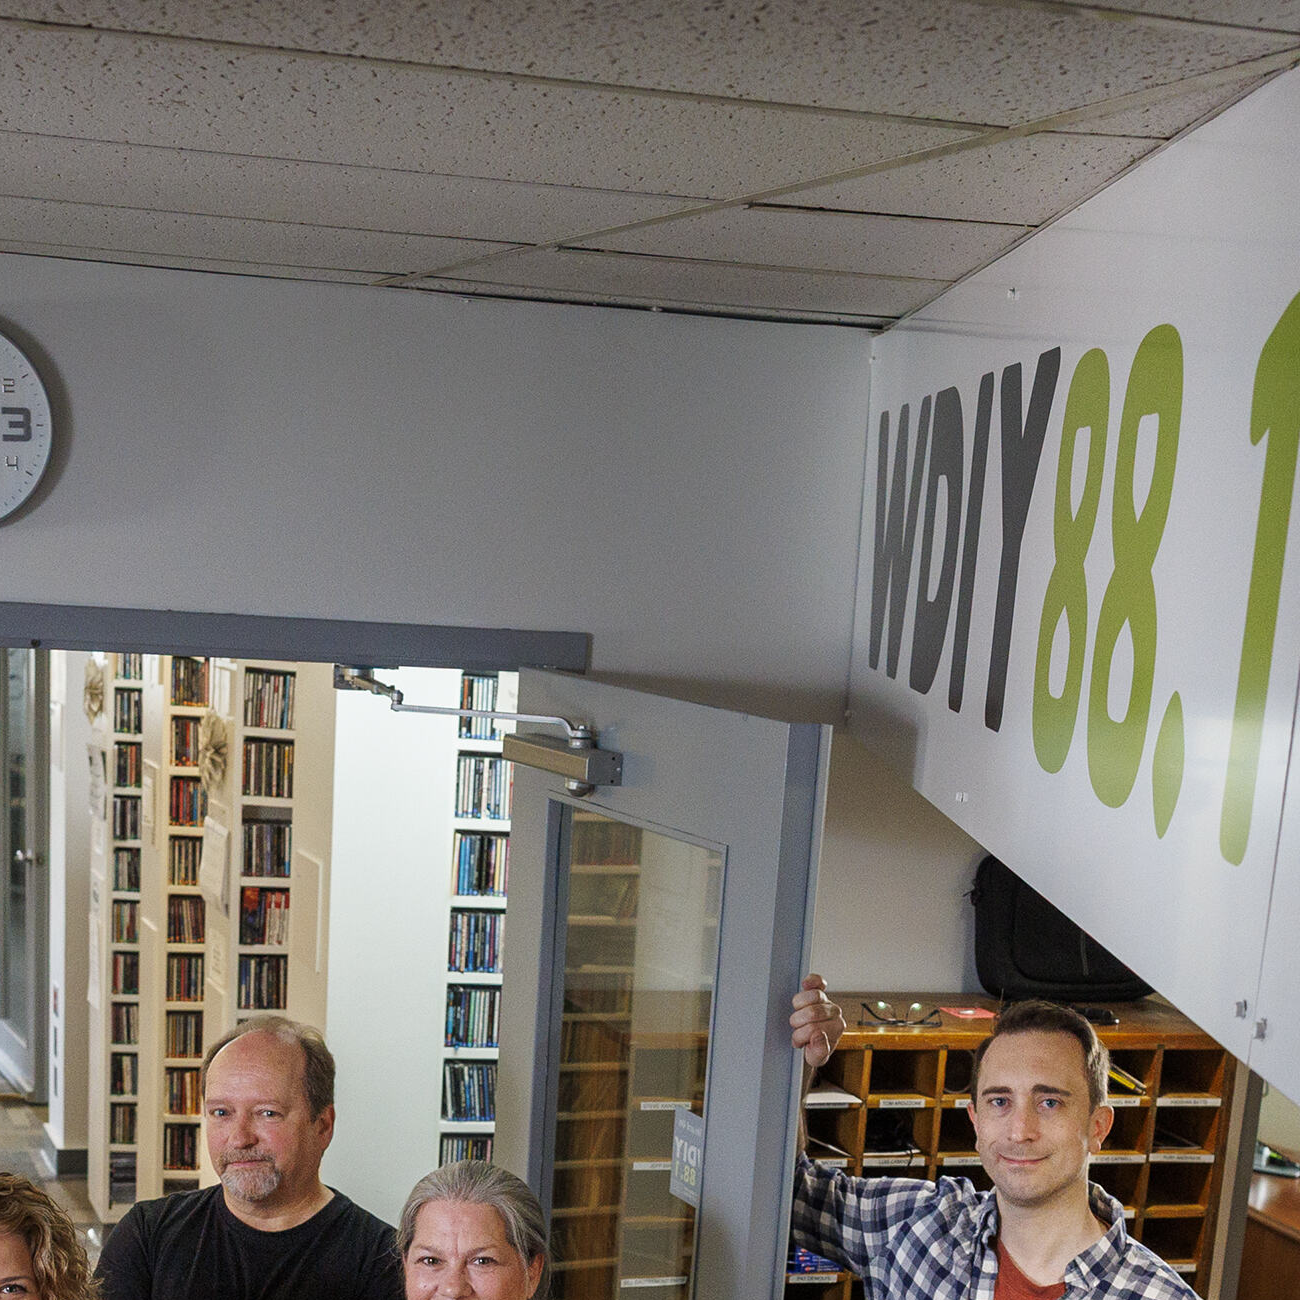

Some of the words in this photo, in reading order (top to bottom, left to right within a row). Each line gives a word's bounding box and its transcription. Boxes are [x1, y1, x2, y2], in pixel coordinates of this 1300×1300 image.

[1, 378, 15, 393] 2
[1, 407, 32, 442] 3
[5, 456, 18, 471] 4
[867, 347, 1063, 731] WDIY
